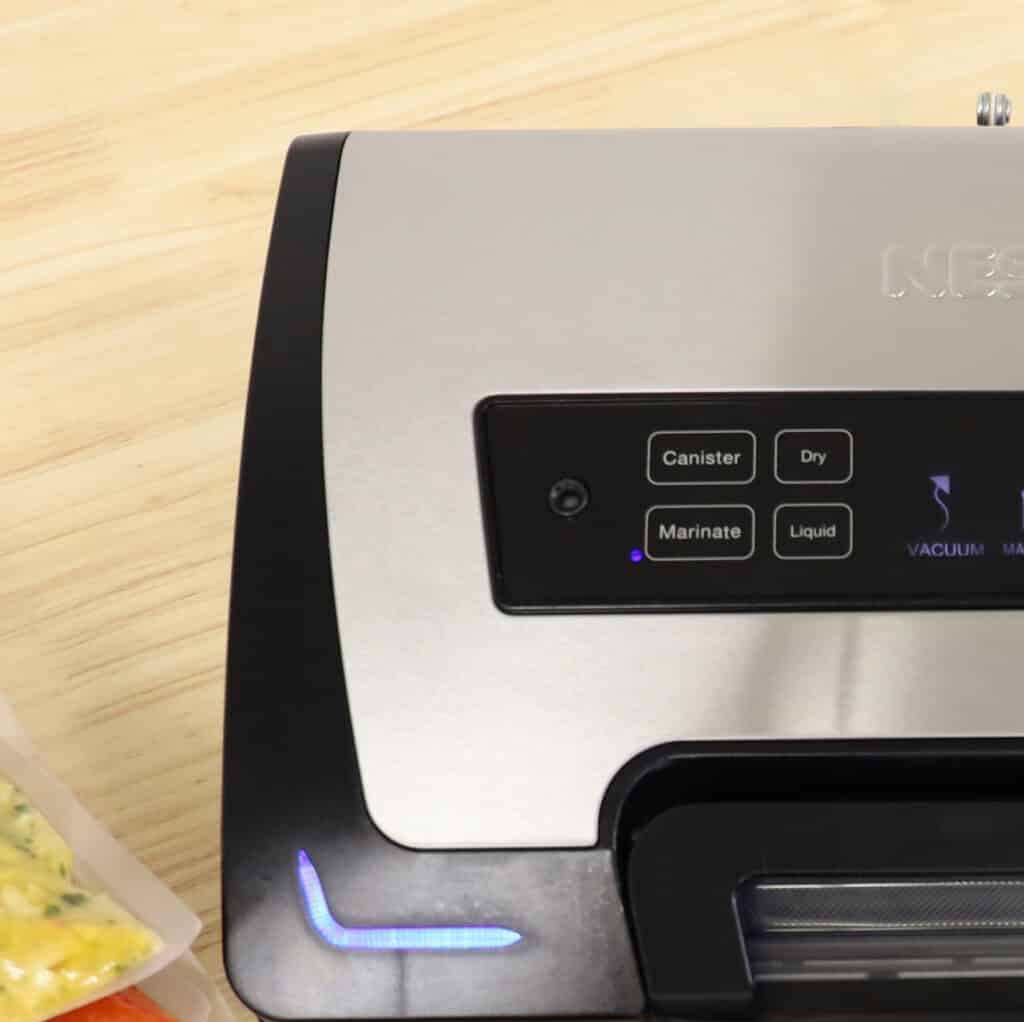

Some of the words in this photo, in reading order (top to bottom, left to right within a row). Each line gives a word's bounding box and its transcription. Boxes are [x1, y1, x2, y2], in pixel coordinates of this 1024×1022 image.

[662, 449, 742, 466] Canister
[800, 447, 827, 466] Dry
[658, 523, 742, 541] Marinate
[789, 523, 837, 541] Liquid
[907, 543, 985, 558] VACUUM
